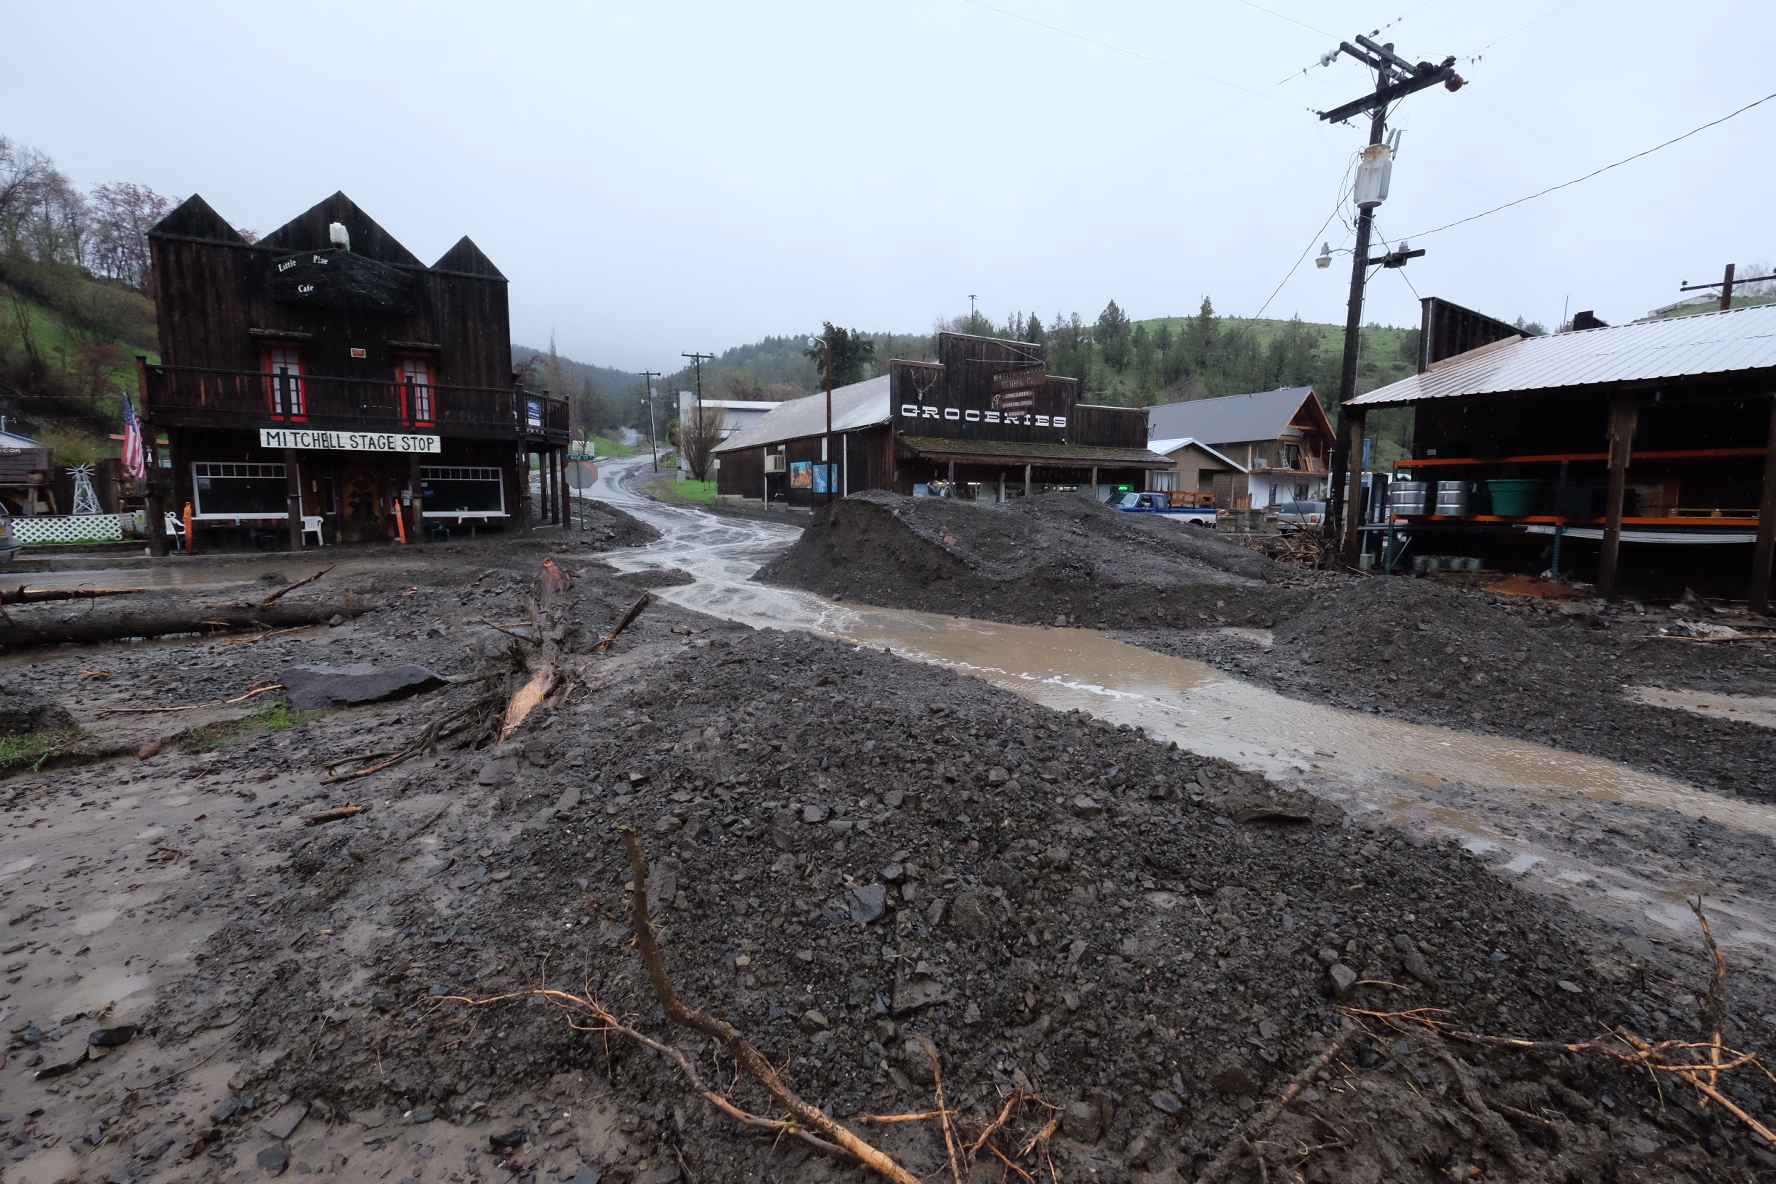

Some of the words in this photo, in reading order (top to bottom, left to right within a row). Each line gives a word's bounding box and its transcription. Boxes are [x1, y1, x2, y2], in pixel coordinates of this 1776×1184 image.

[277, 259, 297, 273] Little
[297, 284, 314, 293] Cafe
[901, 403, 1067, 428] GROCERIES
[266, 431, 345, 449] MITCHELL
[349, 434, 395, 450] STAGE
[401, 435, 435, 451] STOP
